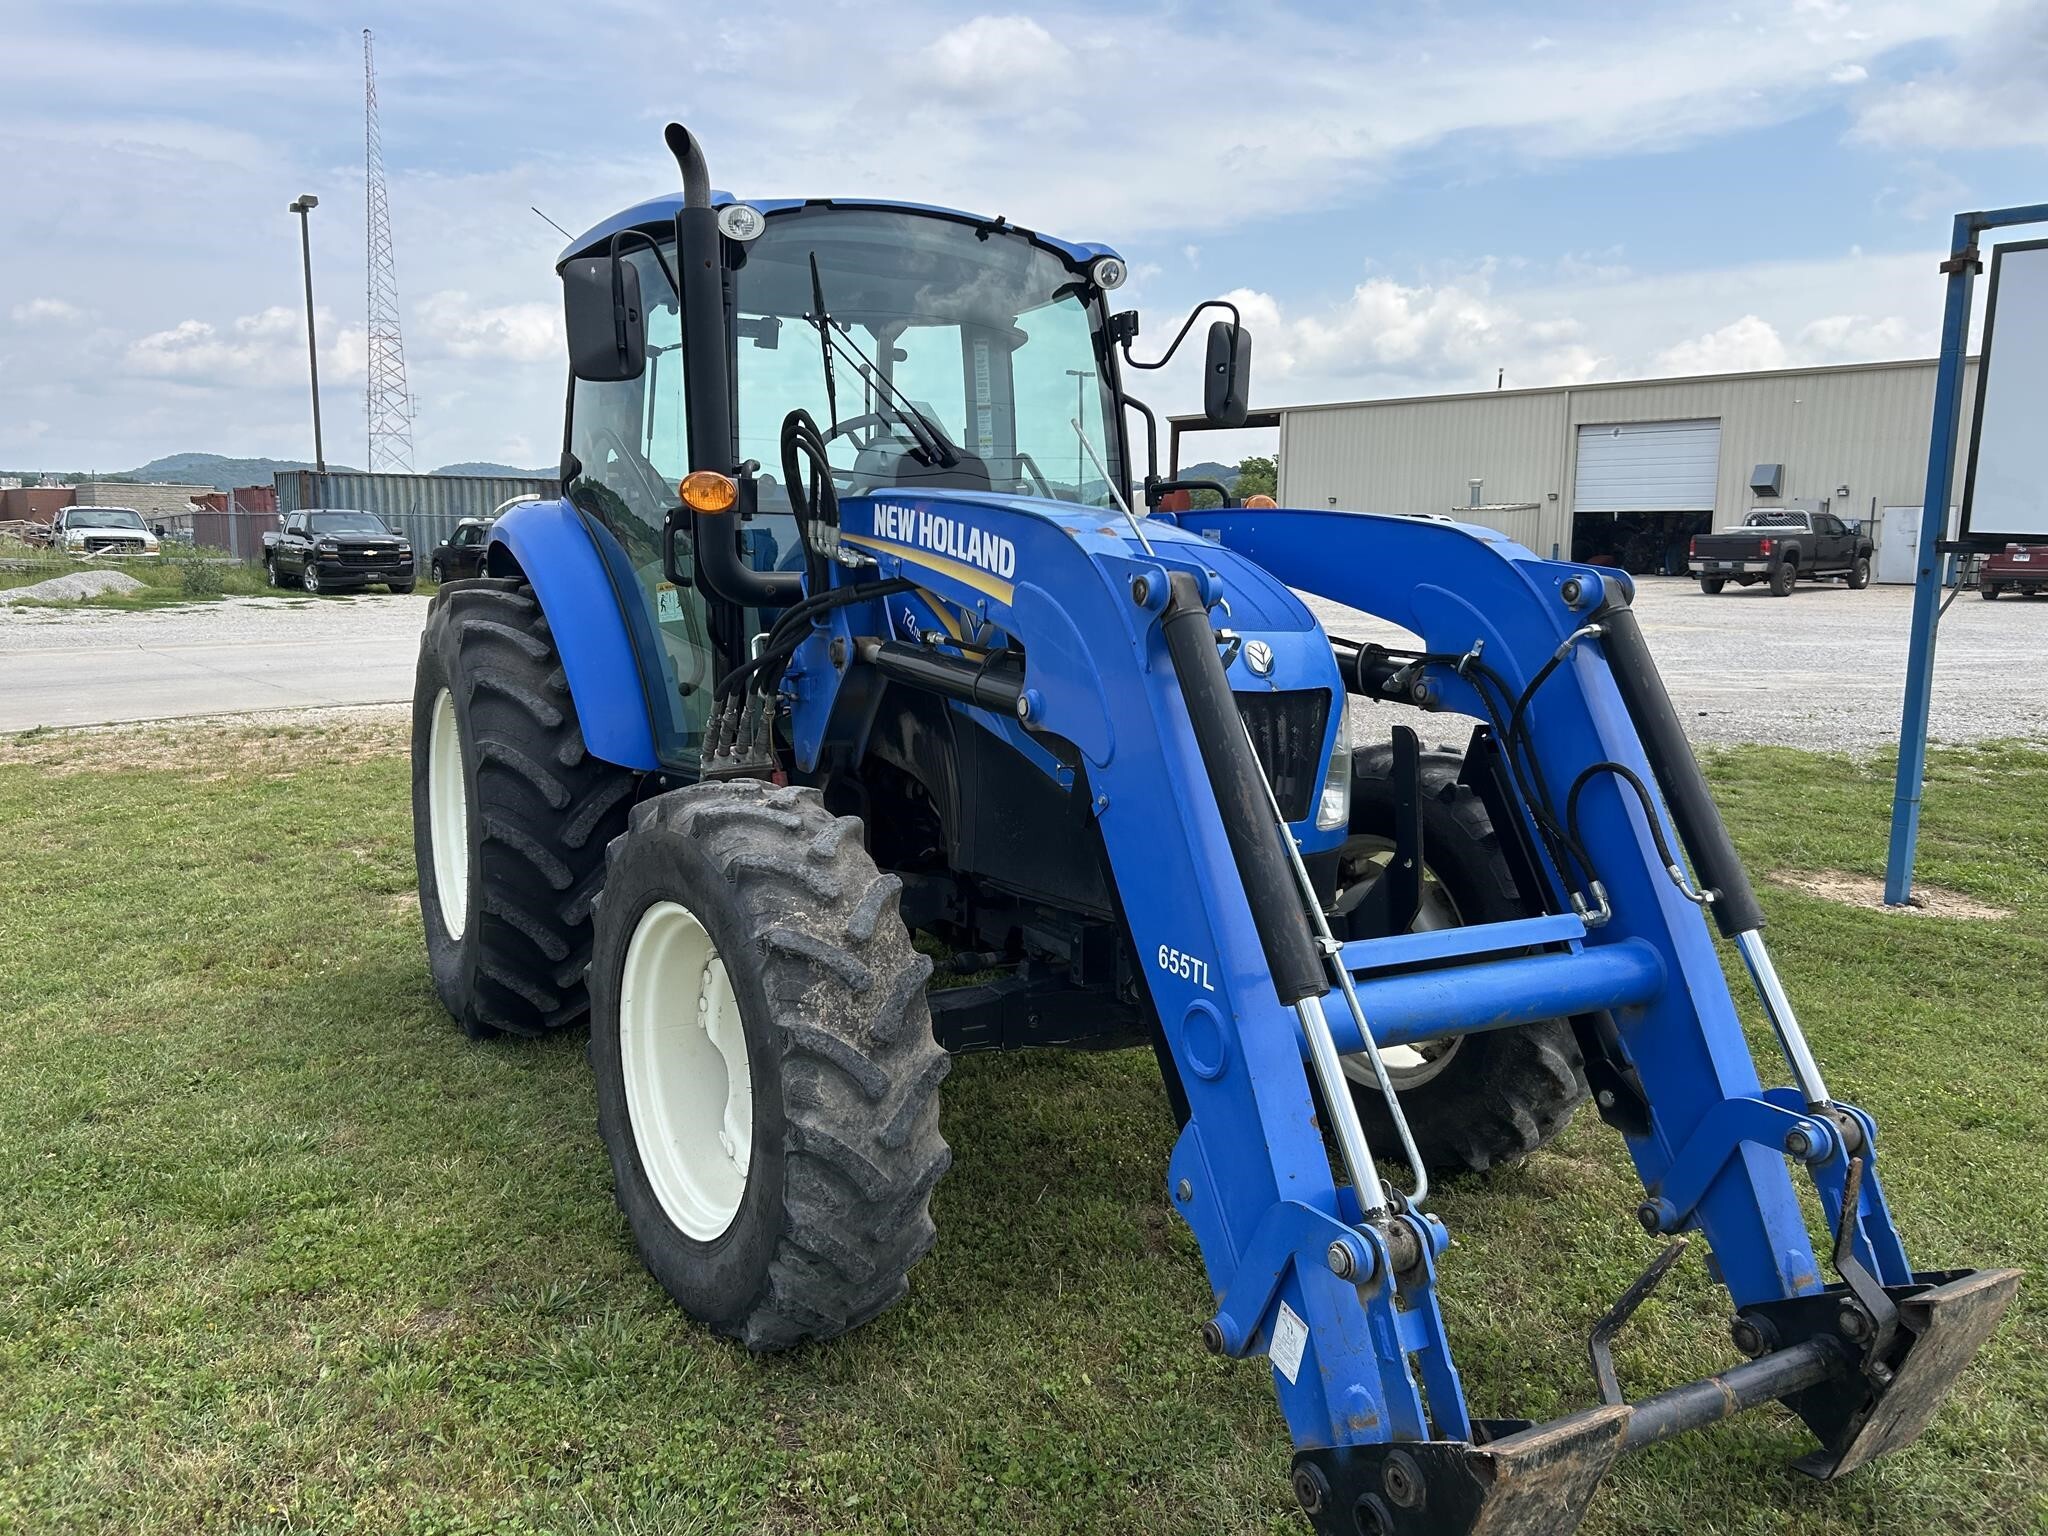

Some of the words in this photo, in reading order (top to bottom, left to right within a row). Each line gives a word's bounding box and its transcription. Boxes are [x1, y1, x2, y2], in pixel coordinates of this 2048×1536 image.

[873, 503, 915, 544] NEW
[918, 512, 1016, 579] HOLLAND
[1158, 944, 1215, 992] 655TL
